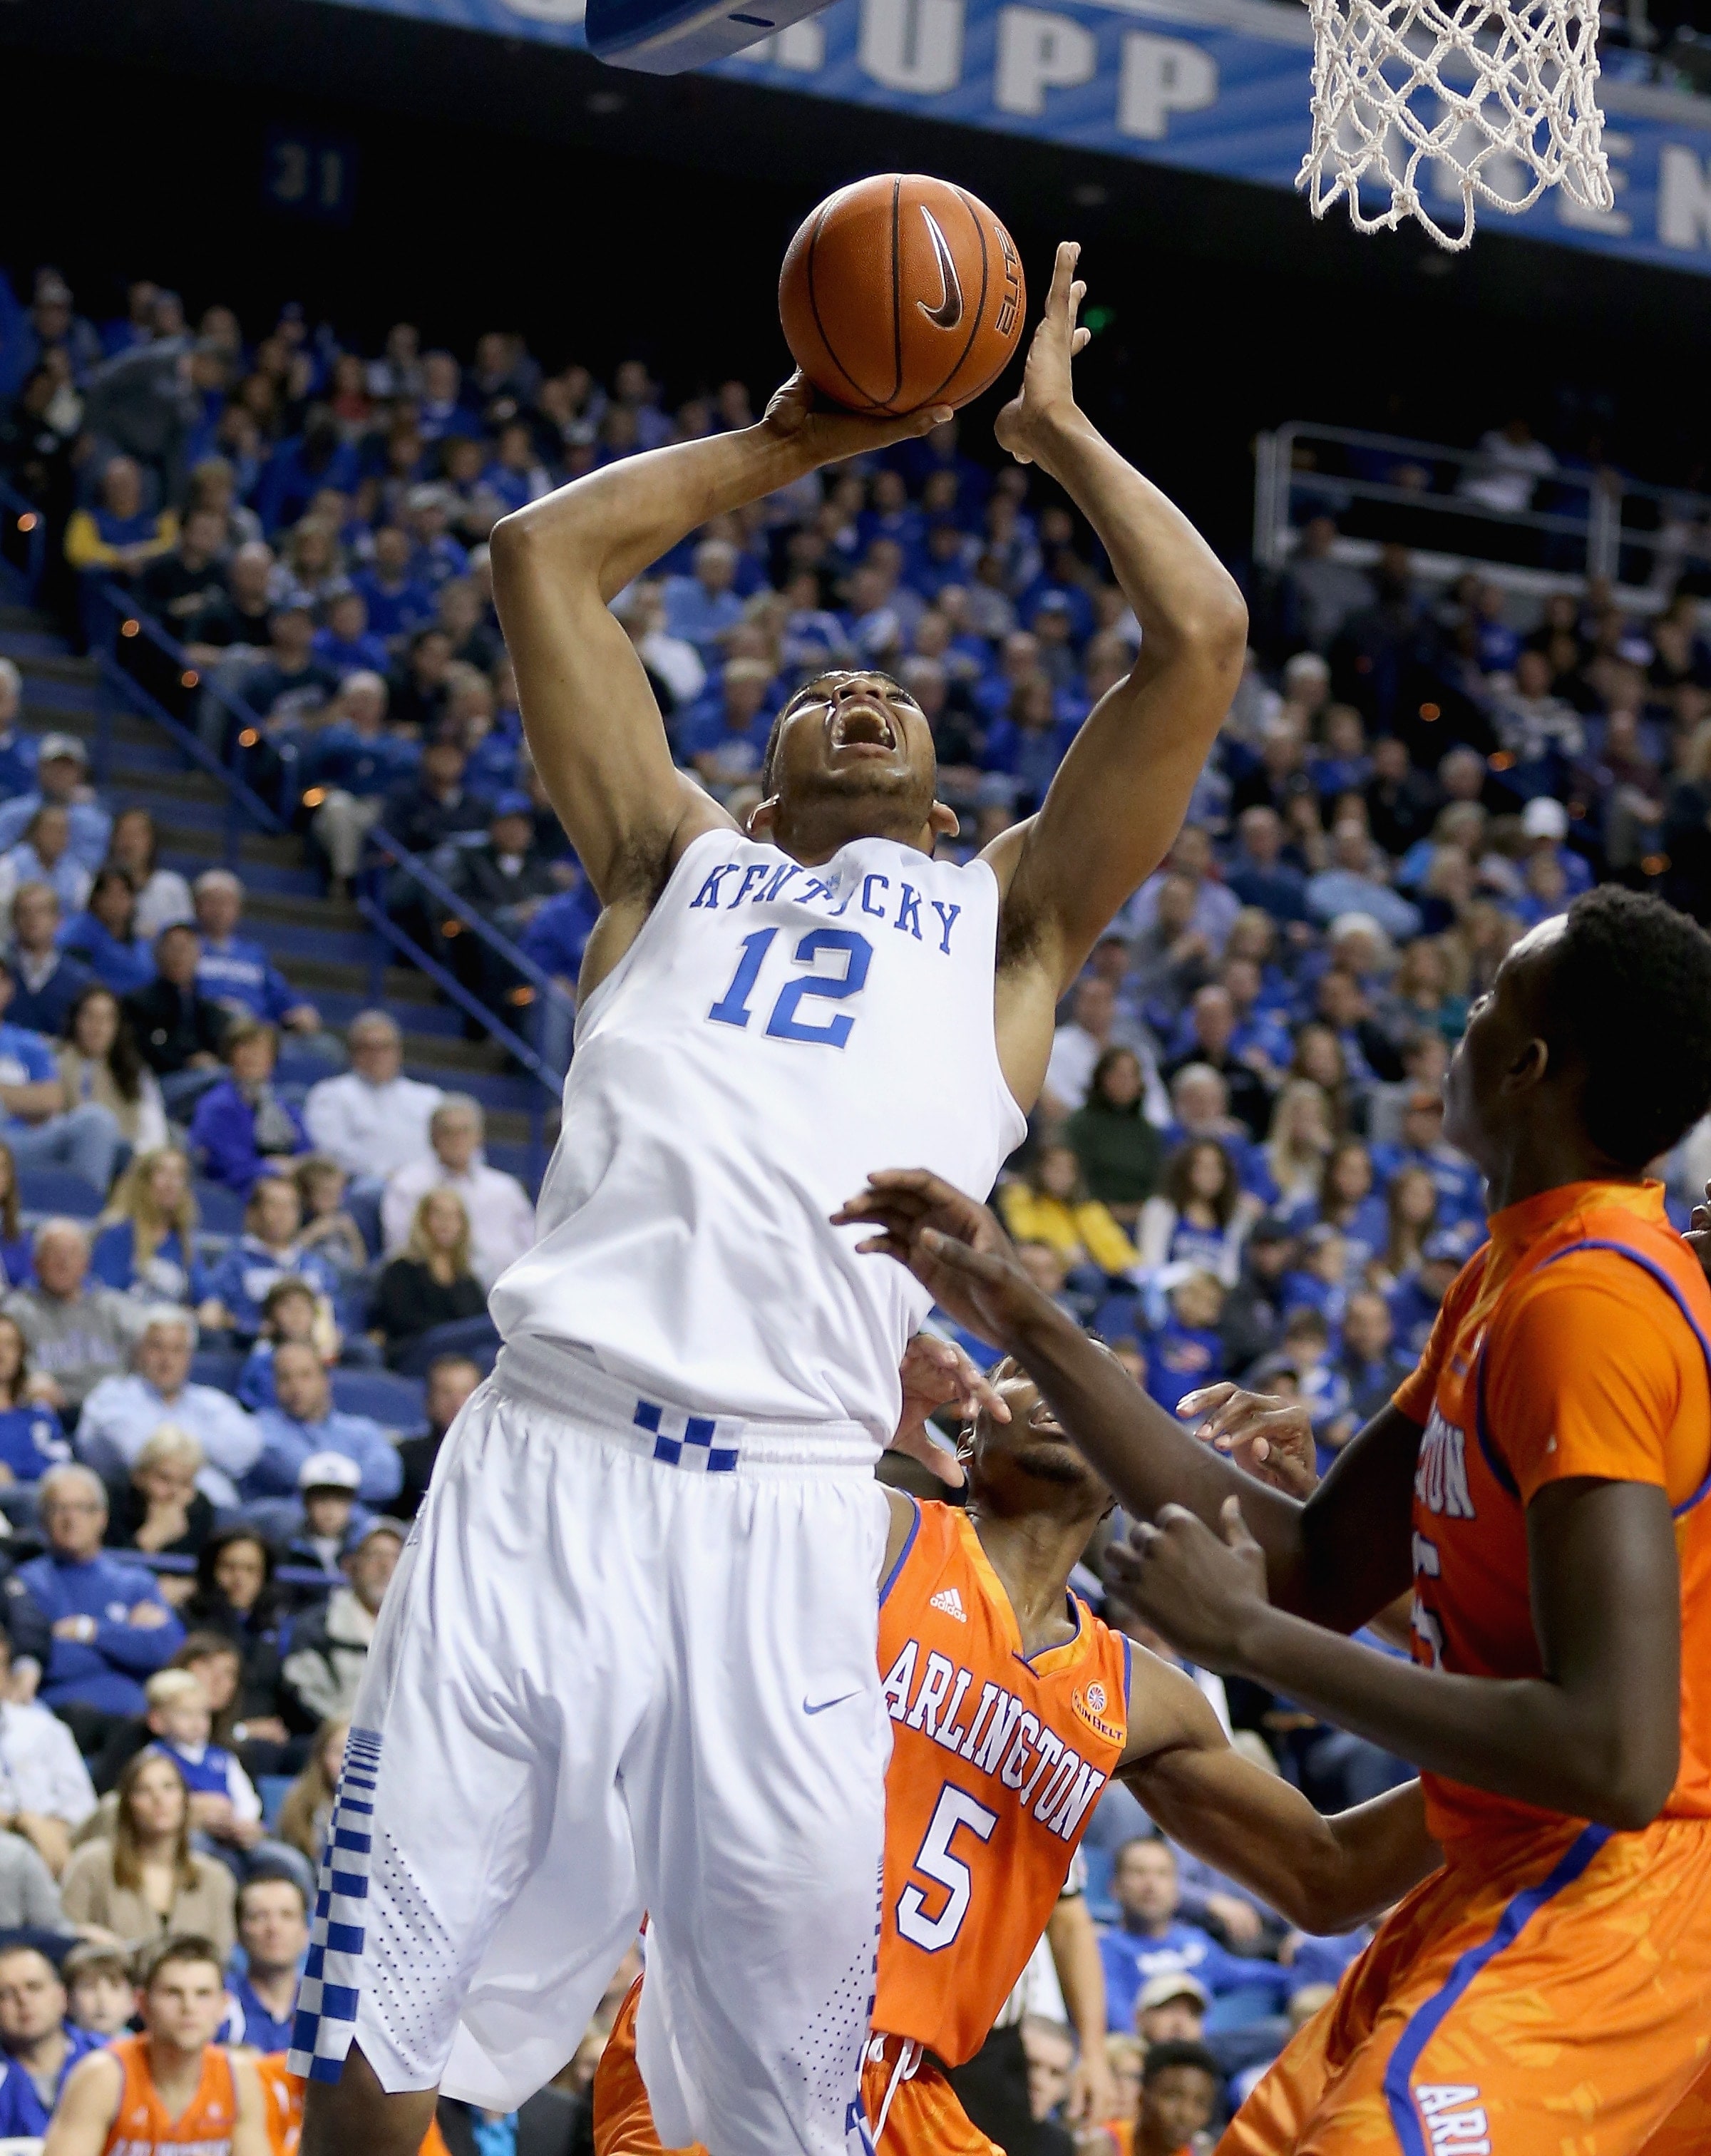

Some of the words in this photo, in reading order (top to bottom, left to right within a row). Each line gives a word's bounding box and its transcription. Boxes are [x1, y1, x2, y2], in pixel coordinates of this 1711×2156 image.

[273, 143, 342, 205] 31
[995, 226, 1020, 337] ELITE
[706, 926, 874, 1051] 12
[929, 1596, 967, 1623] adidas
[882, 1638, 1106, 1842] ARLINGTON
[1093, 1715, 1124, 1740] BELT
[895, 1780, 1000, 1954] 5
